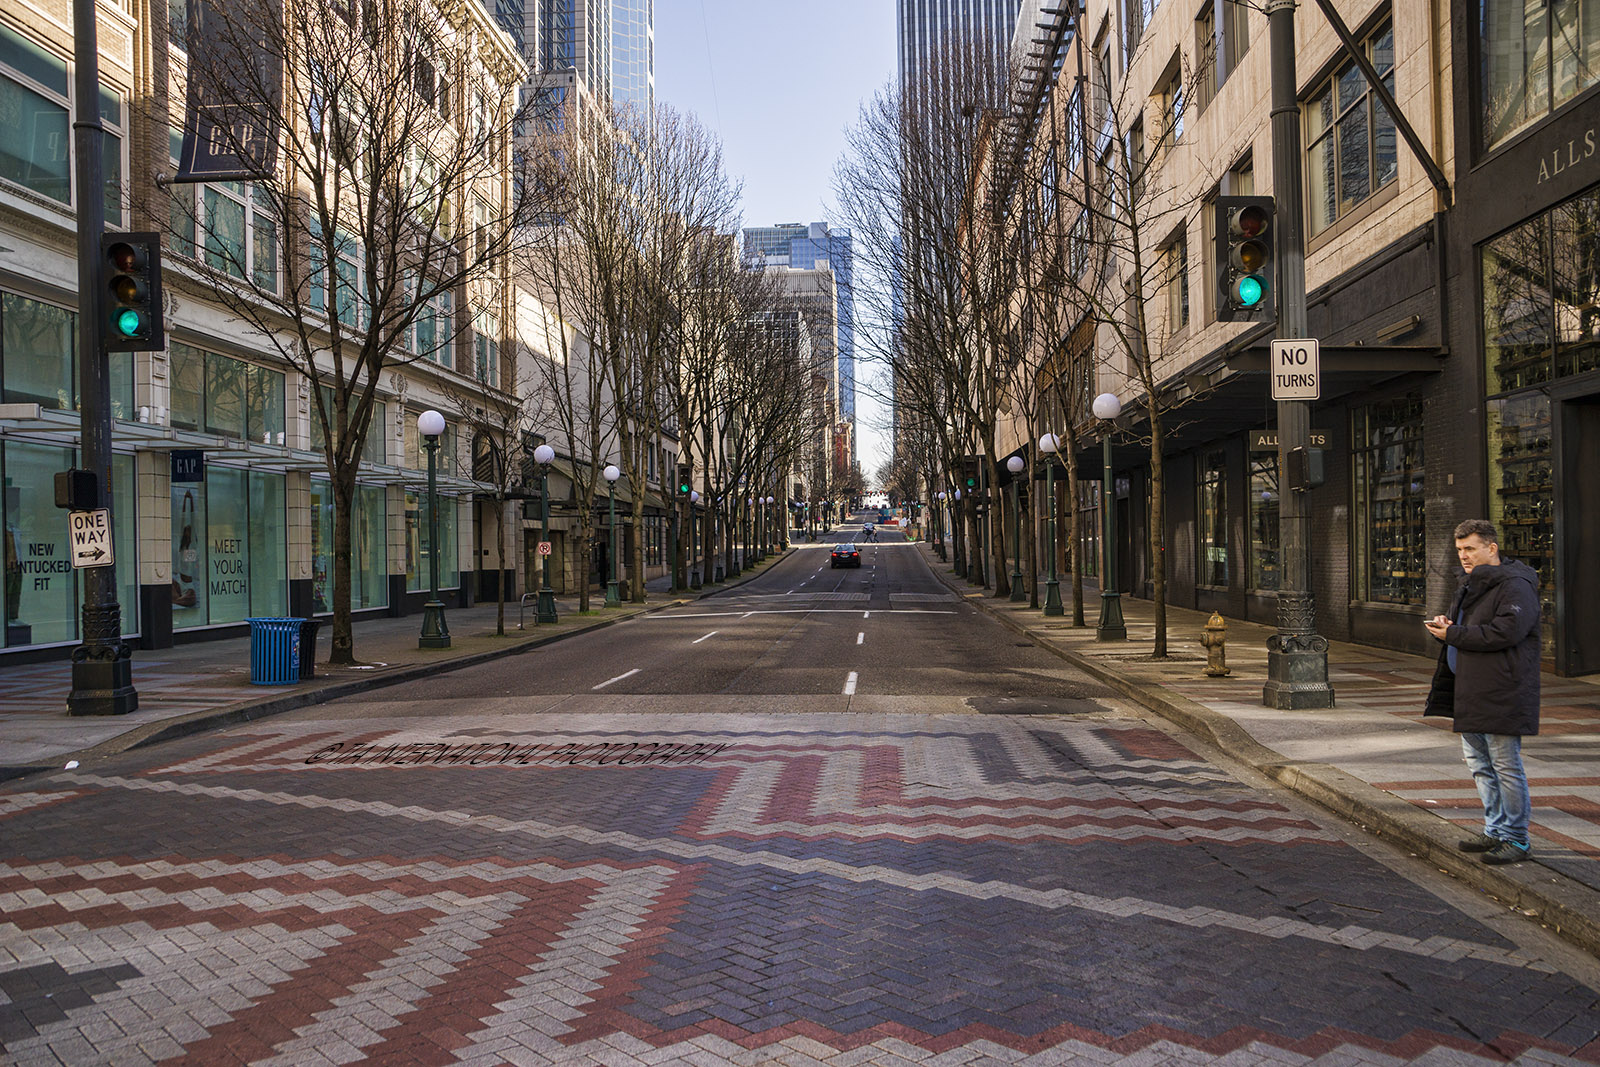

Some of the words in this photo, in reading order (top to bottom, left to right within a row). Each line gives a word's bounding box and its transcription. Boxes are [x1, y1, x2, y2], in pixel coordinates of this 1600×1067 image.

[208, 122, 254, 156] GAP
[1536, 128, 1596, 185] ALLS
[1281, 348, 1308, 366] NO
[1275, 373, 1316, 388] TURNS
[176, 458, 197, 474] GAP
[74, 514, 105, 530] ONE
[74, 529, 106, 545] WAY
[29, 543, 55, 557] NEW
[214, 538, 242, 554] MEET
[10, 559, 72, 575] UNTUCKED
[213, 558, 244, 575] YOUR
[34, 577, 51, 591] FIT
[210, 579, 247, 596] MATCH
